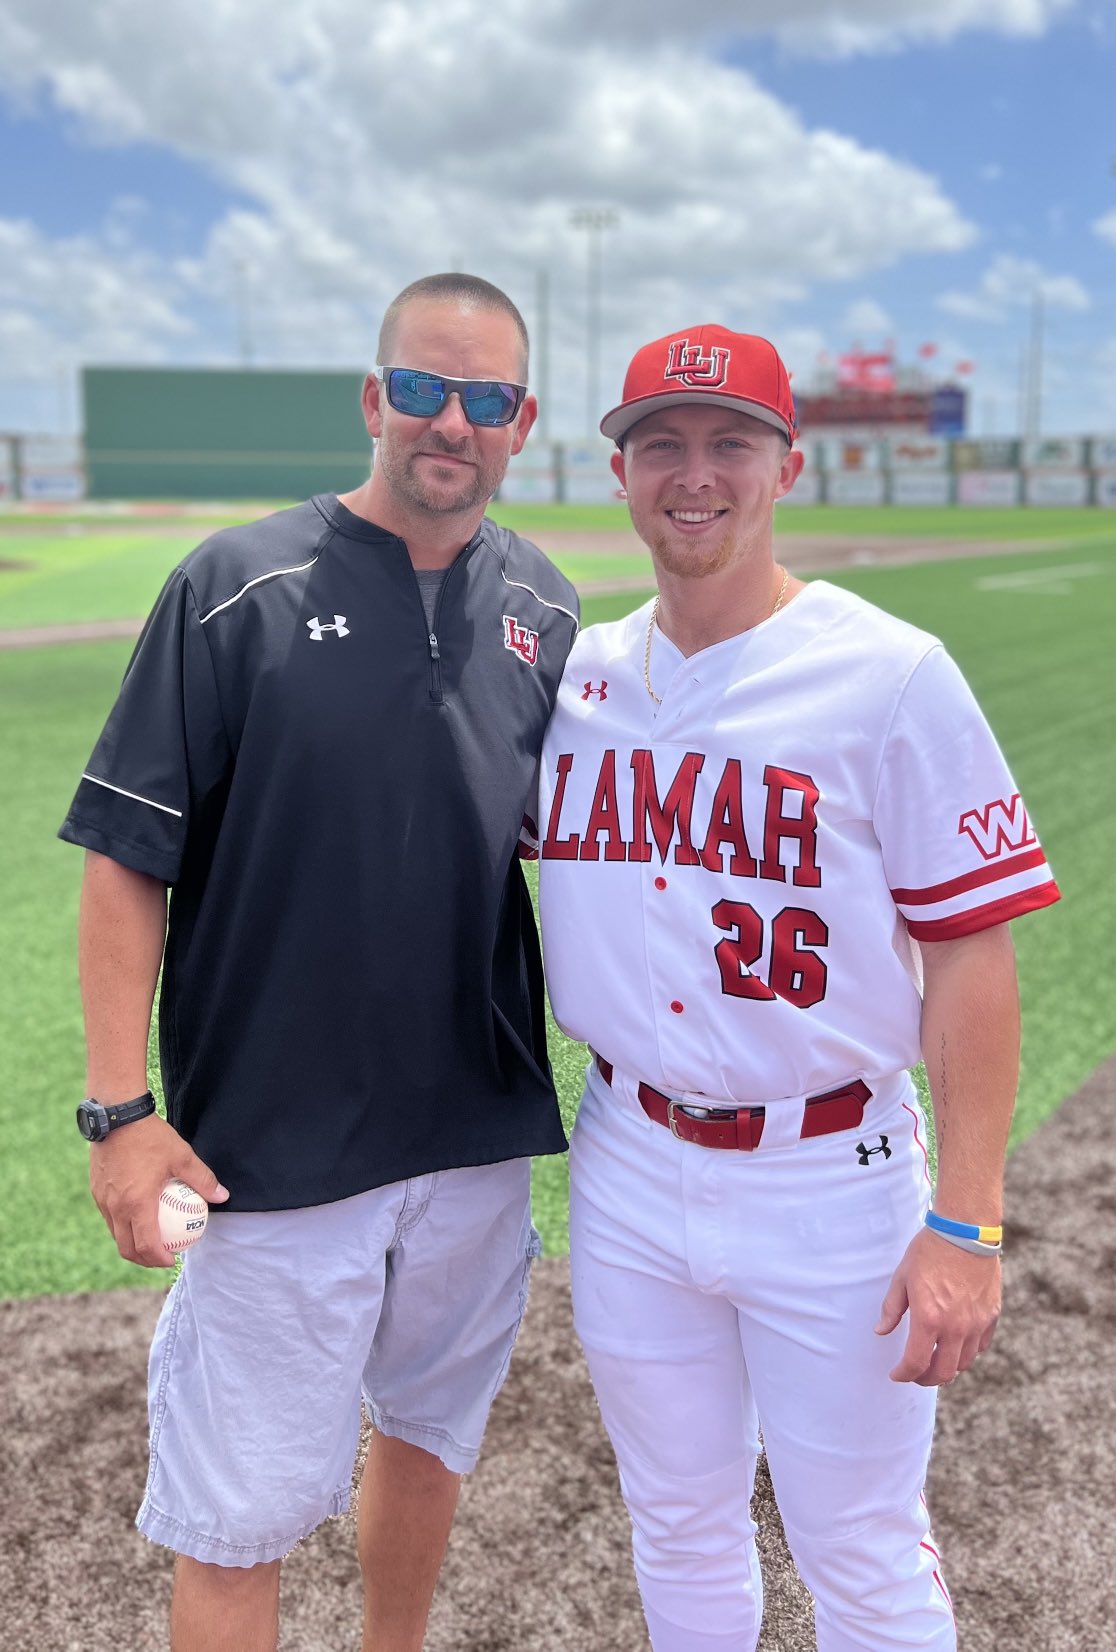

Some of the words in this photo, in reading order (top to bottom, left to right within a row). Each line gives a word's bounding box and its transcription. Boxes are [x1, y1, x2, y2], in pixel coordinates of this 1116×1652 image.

[664, 339, 730, 388] LU
[502, 615, 539, 667] LU
[541, 749, 822, 888] LAMAR
[711, 898, 829, 1009] 26
